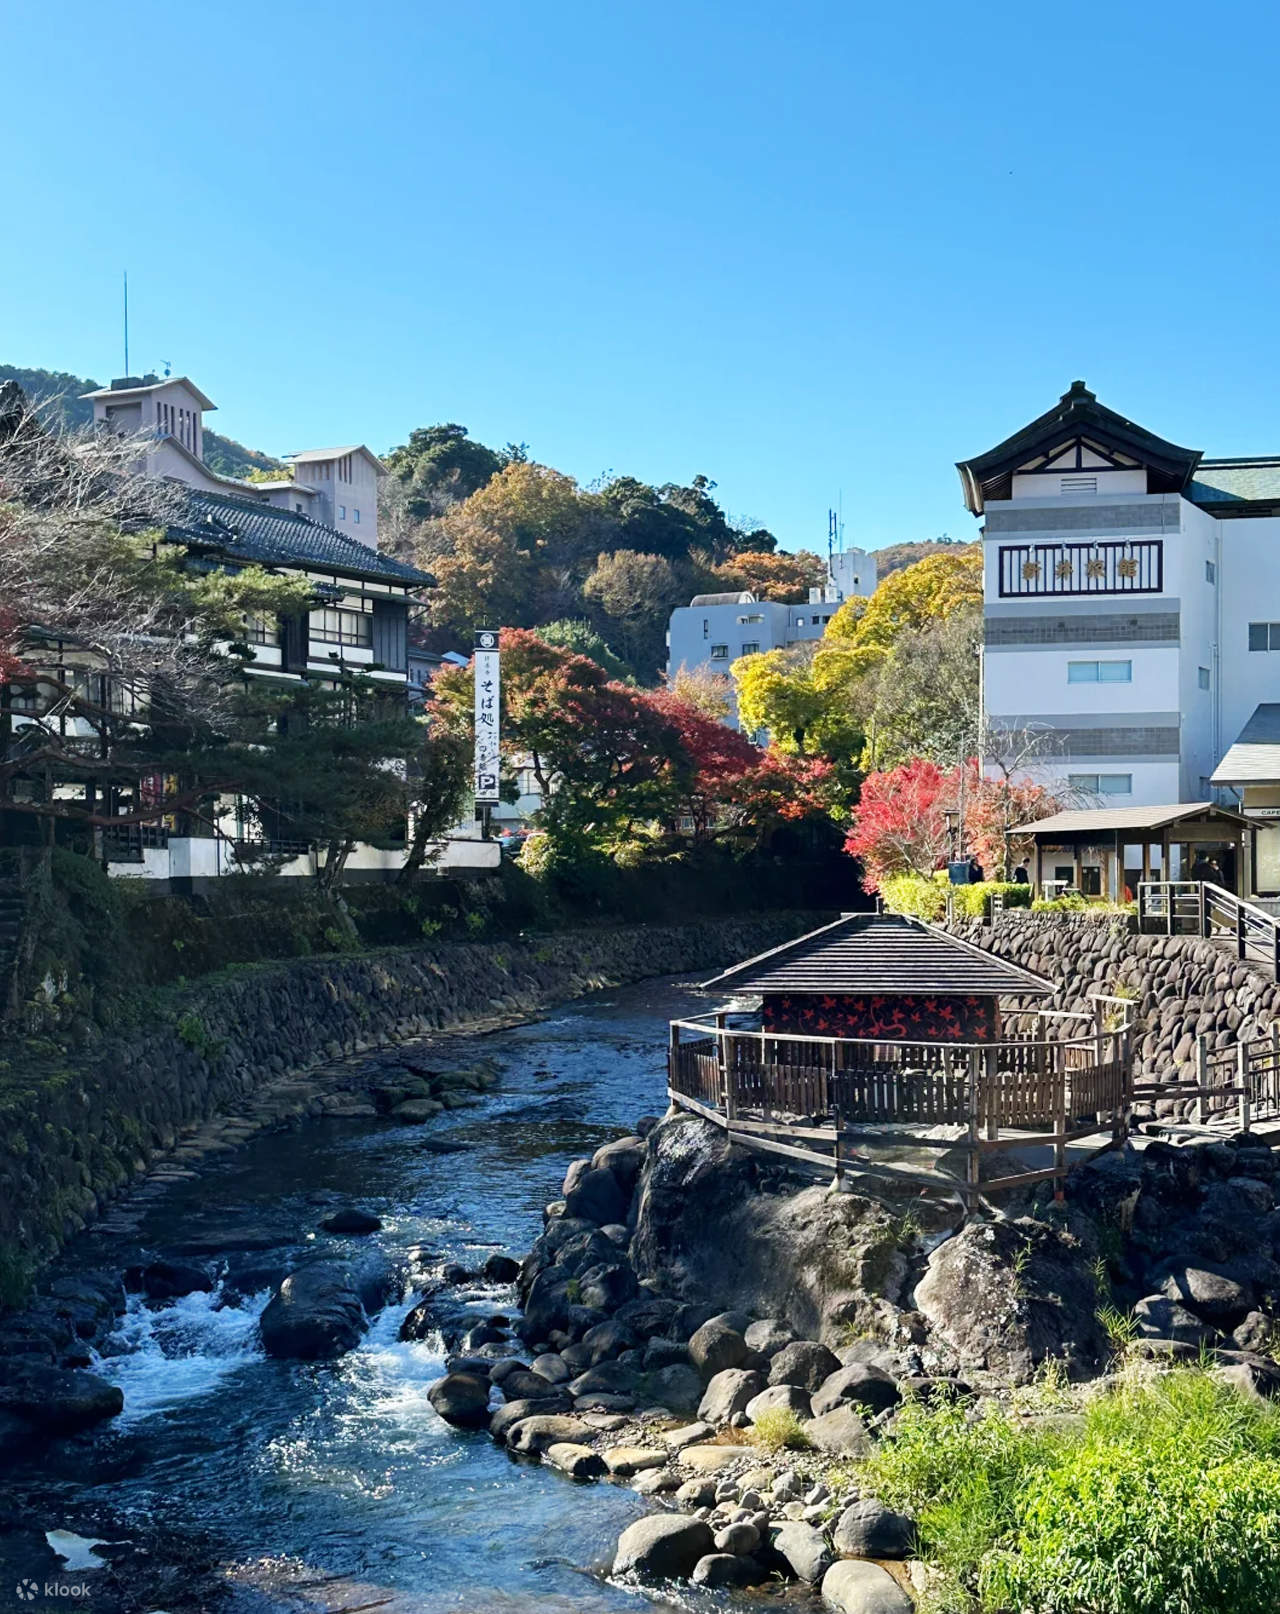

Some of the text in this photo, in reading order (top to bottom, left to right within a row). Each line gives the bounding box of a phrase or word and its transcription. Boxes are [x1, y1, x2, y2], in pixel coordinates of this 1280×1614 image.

[480, 679, 494, 727] そば処
[480, 775, 495, 789] P
